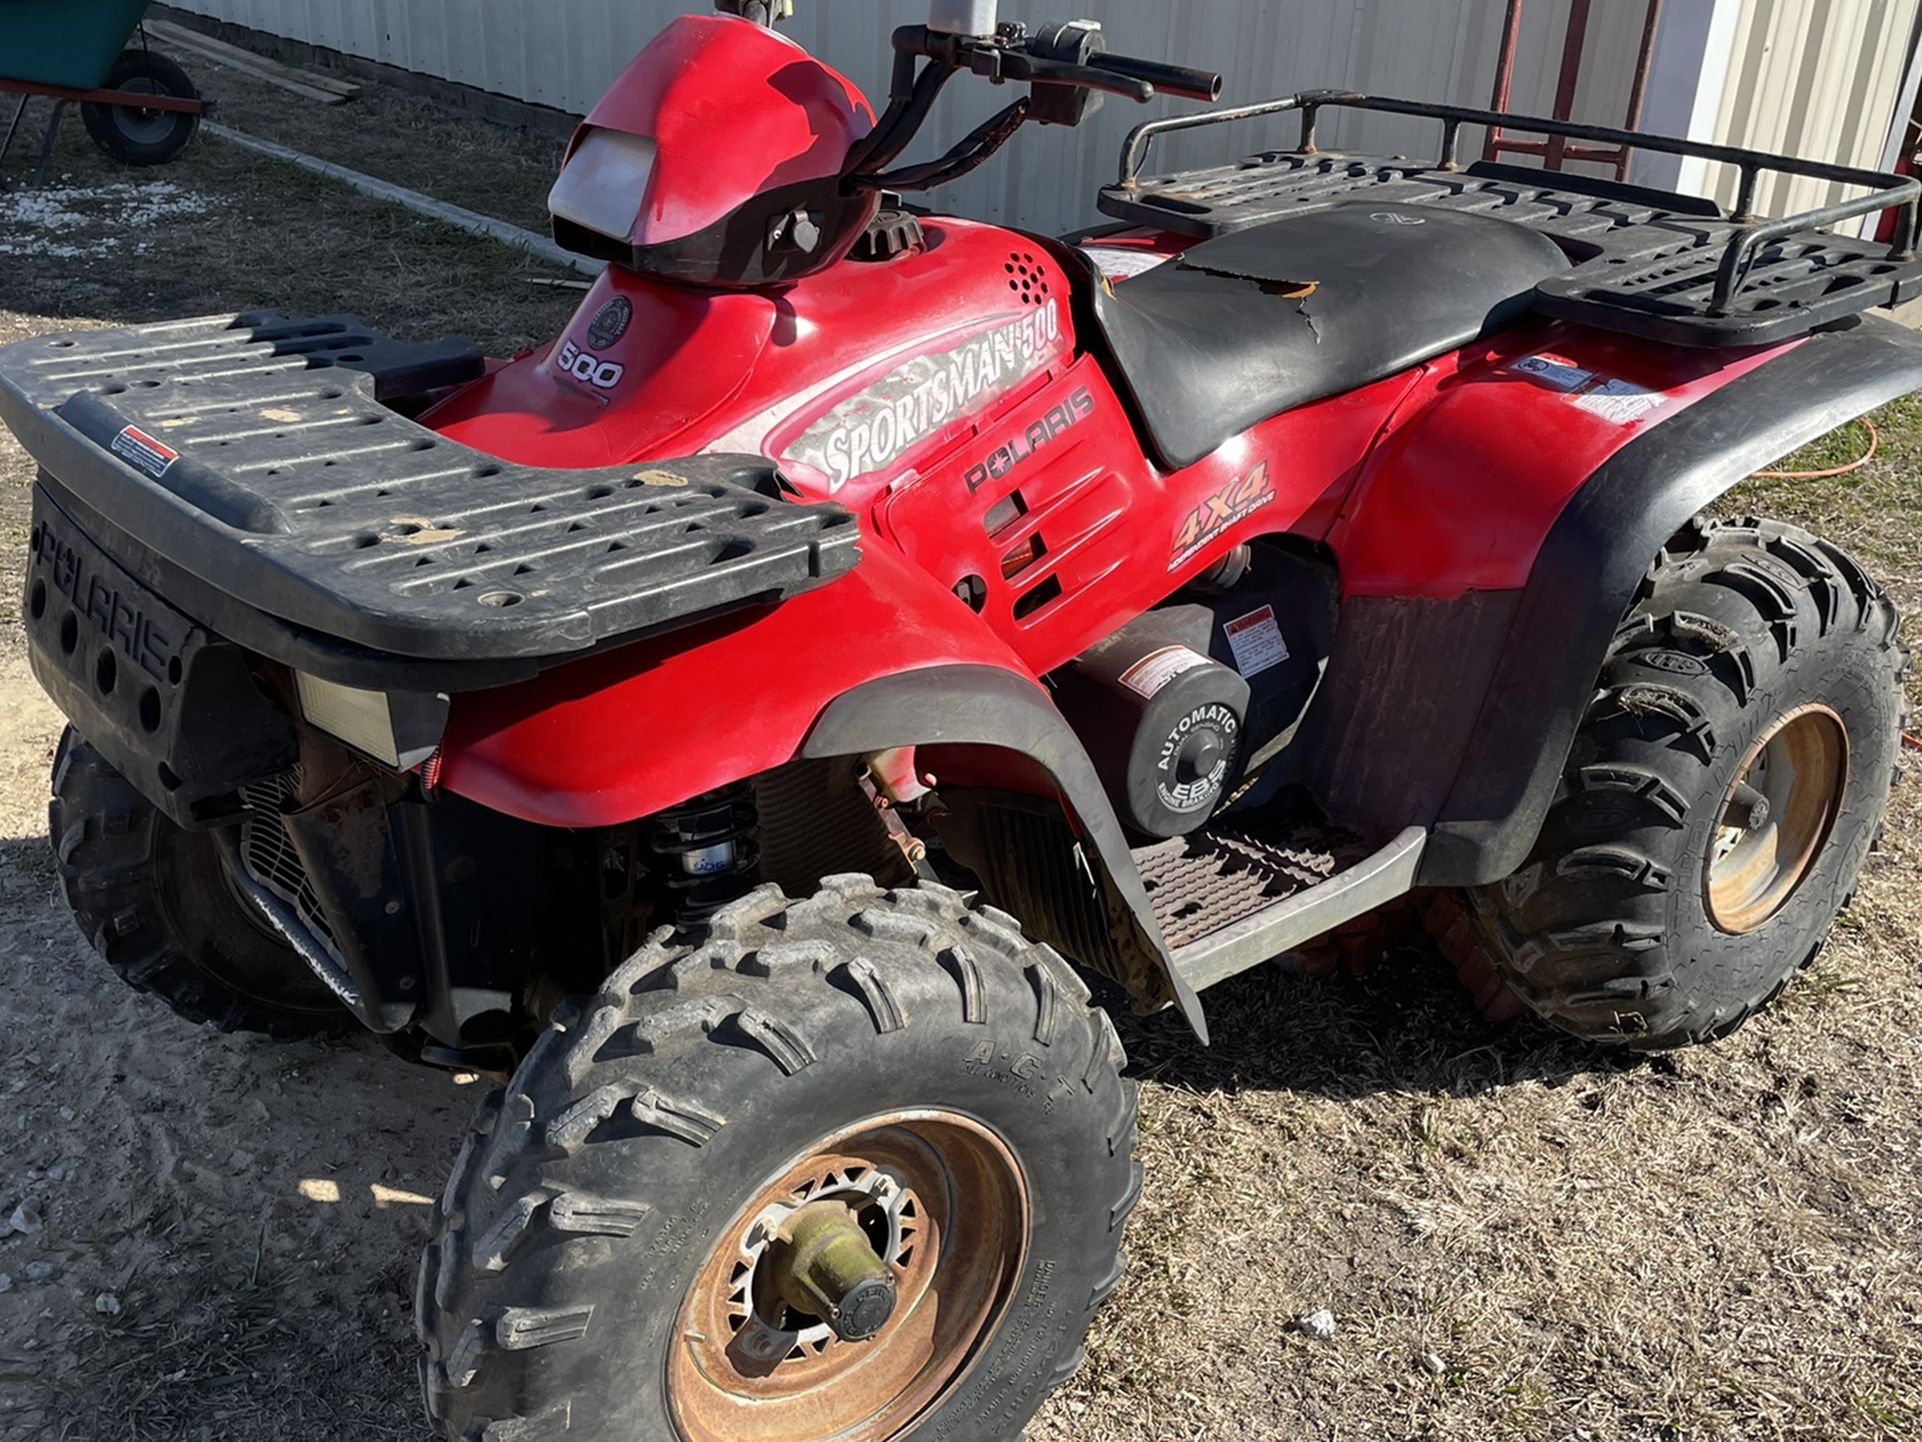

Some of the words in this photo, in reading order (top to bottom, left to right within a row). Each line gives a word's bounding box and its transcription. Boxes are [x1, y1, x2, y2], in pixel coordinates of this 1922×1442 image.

[557, 339, 625, 389] 500
[823, 322, 1016, 495] SPORTSMAN
[1021, 297, 1057, 360] 500
[963, 385, 1095, 496] POLARIS
[1172, 460, 1269, 555] 4X4
[36, 520, 167, 683] POLARIS
[1158, 704, 1237, 772] AUTOMATIC
[1172, 759, 1227, 801] EBS
